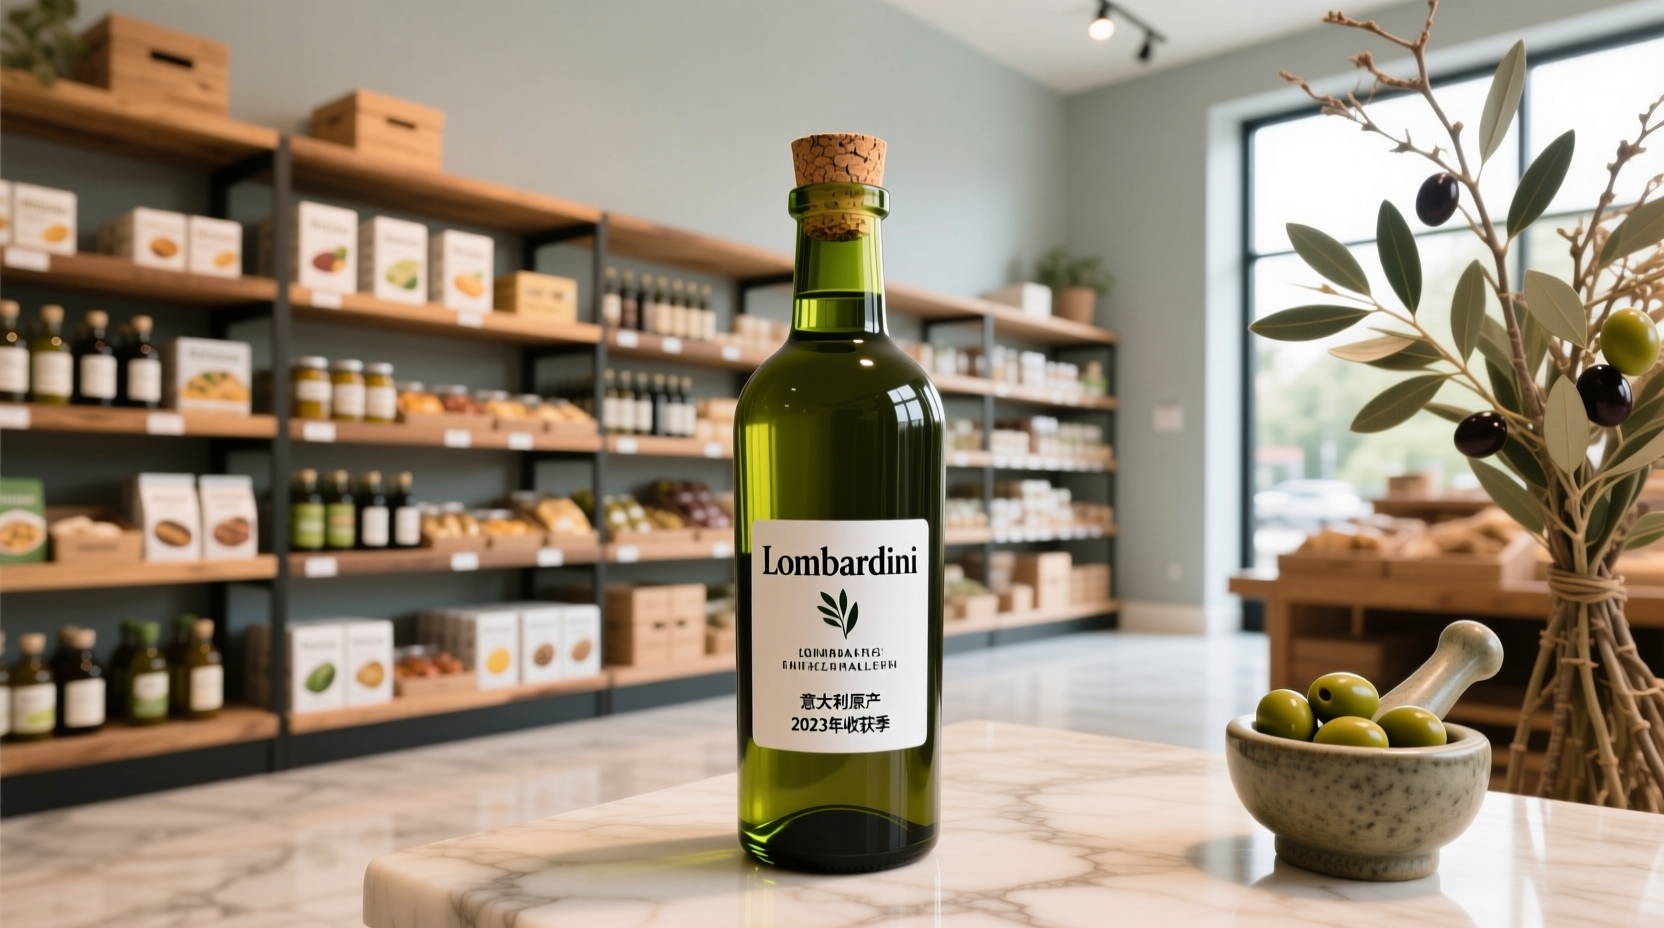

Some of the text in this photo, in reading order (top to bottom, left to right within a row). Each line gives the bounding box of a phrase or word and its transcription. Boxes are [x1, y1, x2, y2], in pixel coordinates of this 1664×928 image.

[761, 545, 918, 576] Lombardini
[799, 692, 881, 710] 意大利原产
[791, 715, 890, 734] 2023年收获季
